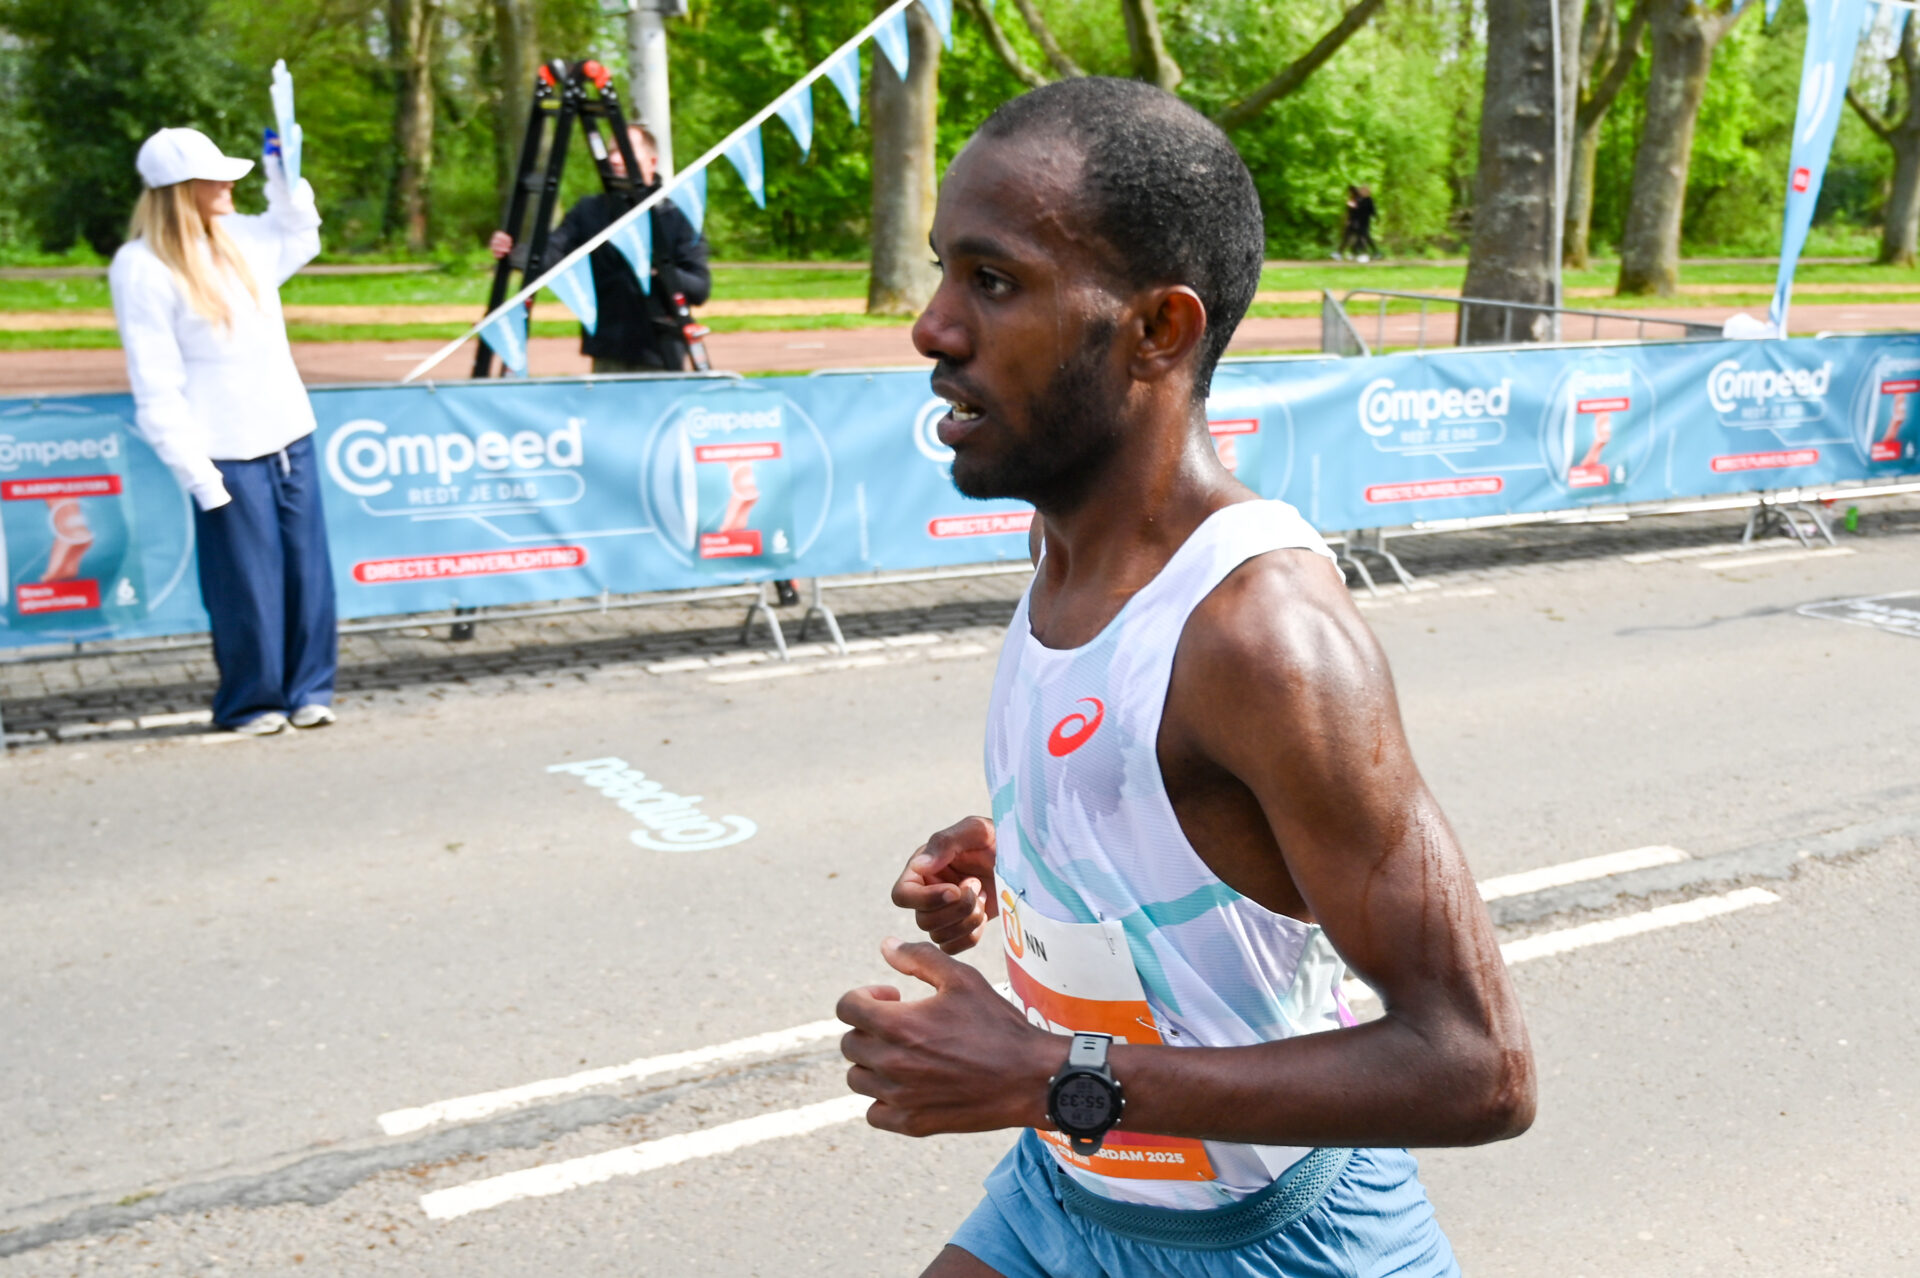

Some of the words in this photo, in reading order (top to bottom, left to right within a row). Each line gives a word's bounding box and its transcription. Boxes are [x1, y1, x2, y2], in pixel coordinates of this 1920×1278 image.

[1707, 359, 1832, 413] Compeed
[685, 406, 781, 438] Compeed
[1358, 377, 1512, 437] Compeed
[326, 417, 583, 497] Compeed
[408, 486, 459, 506] REDT
[468, 484, 491, 502] JE
[497, 482, 538, 501] DAG
[363, 560, 435, 581] DIRECTE
[438, 548, 578, 576] PIJNVERLICHTING
[546, 756, 757, 852] Compeed
[1024, 929, 1048, 962] NN
[1145, 1150, 1185, 1164] 2025
